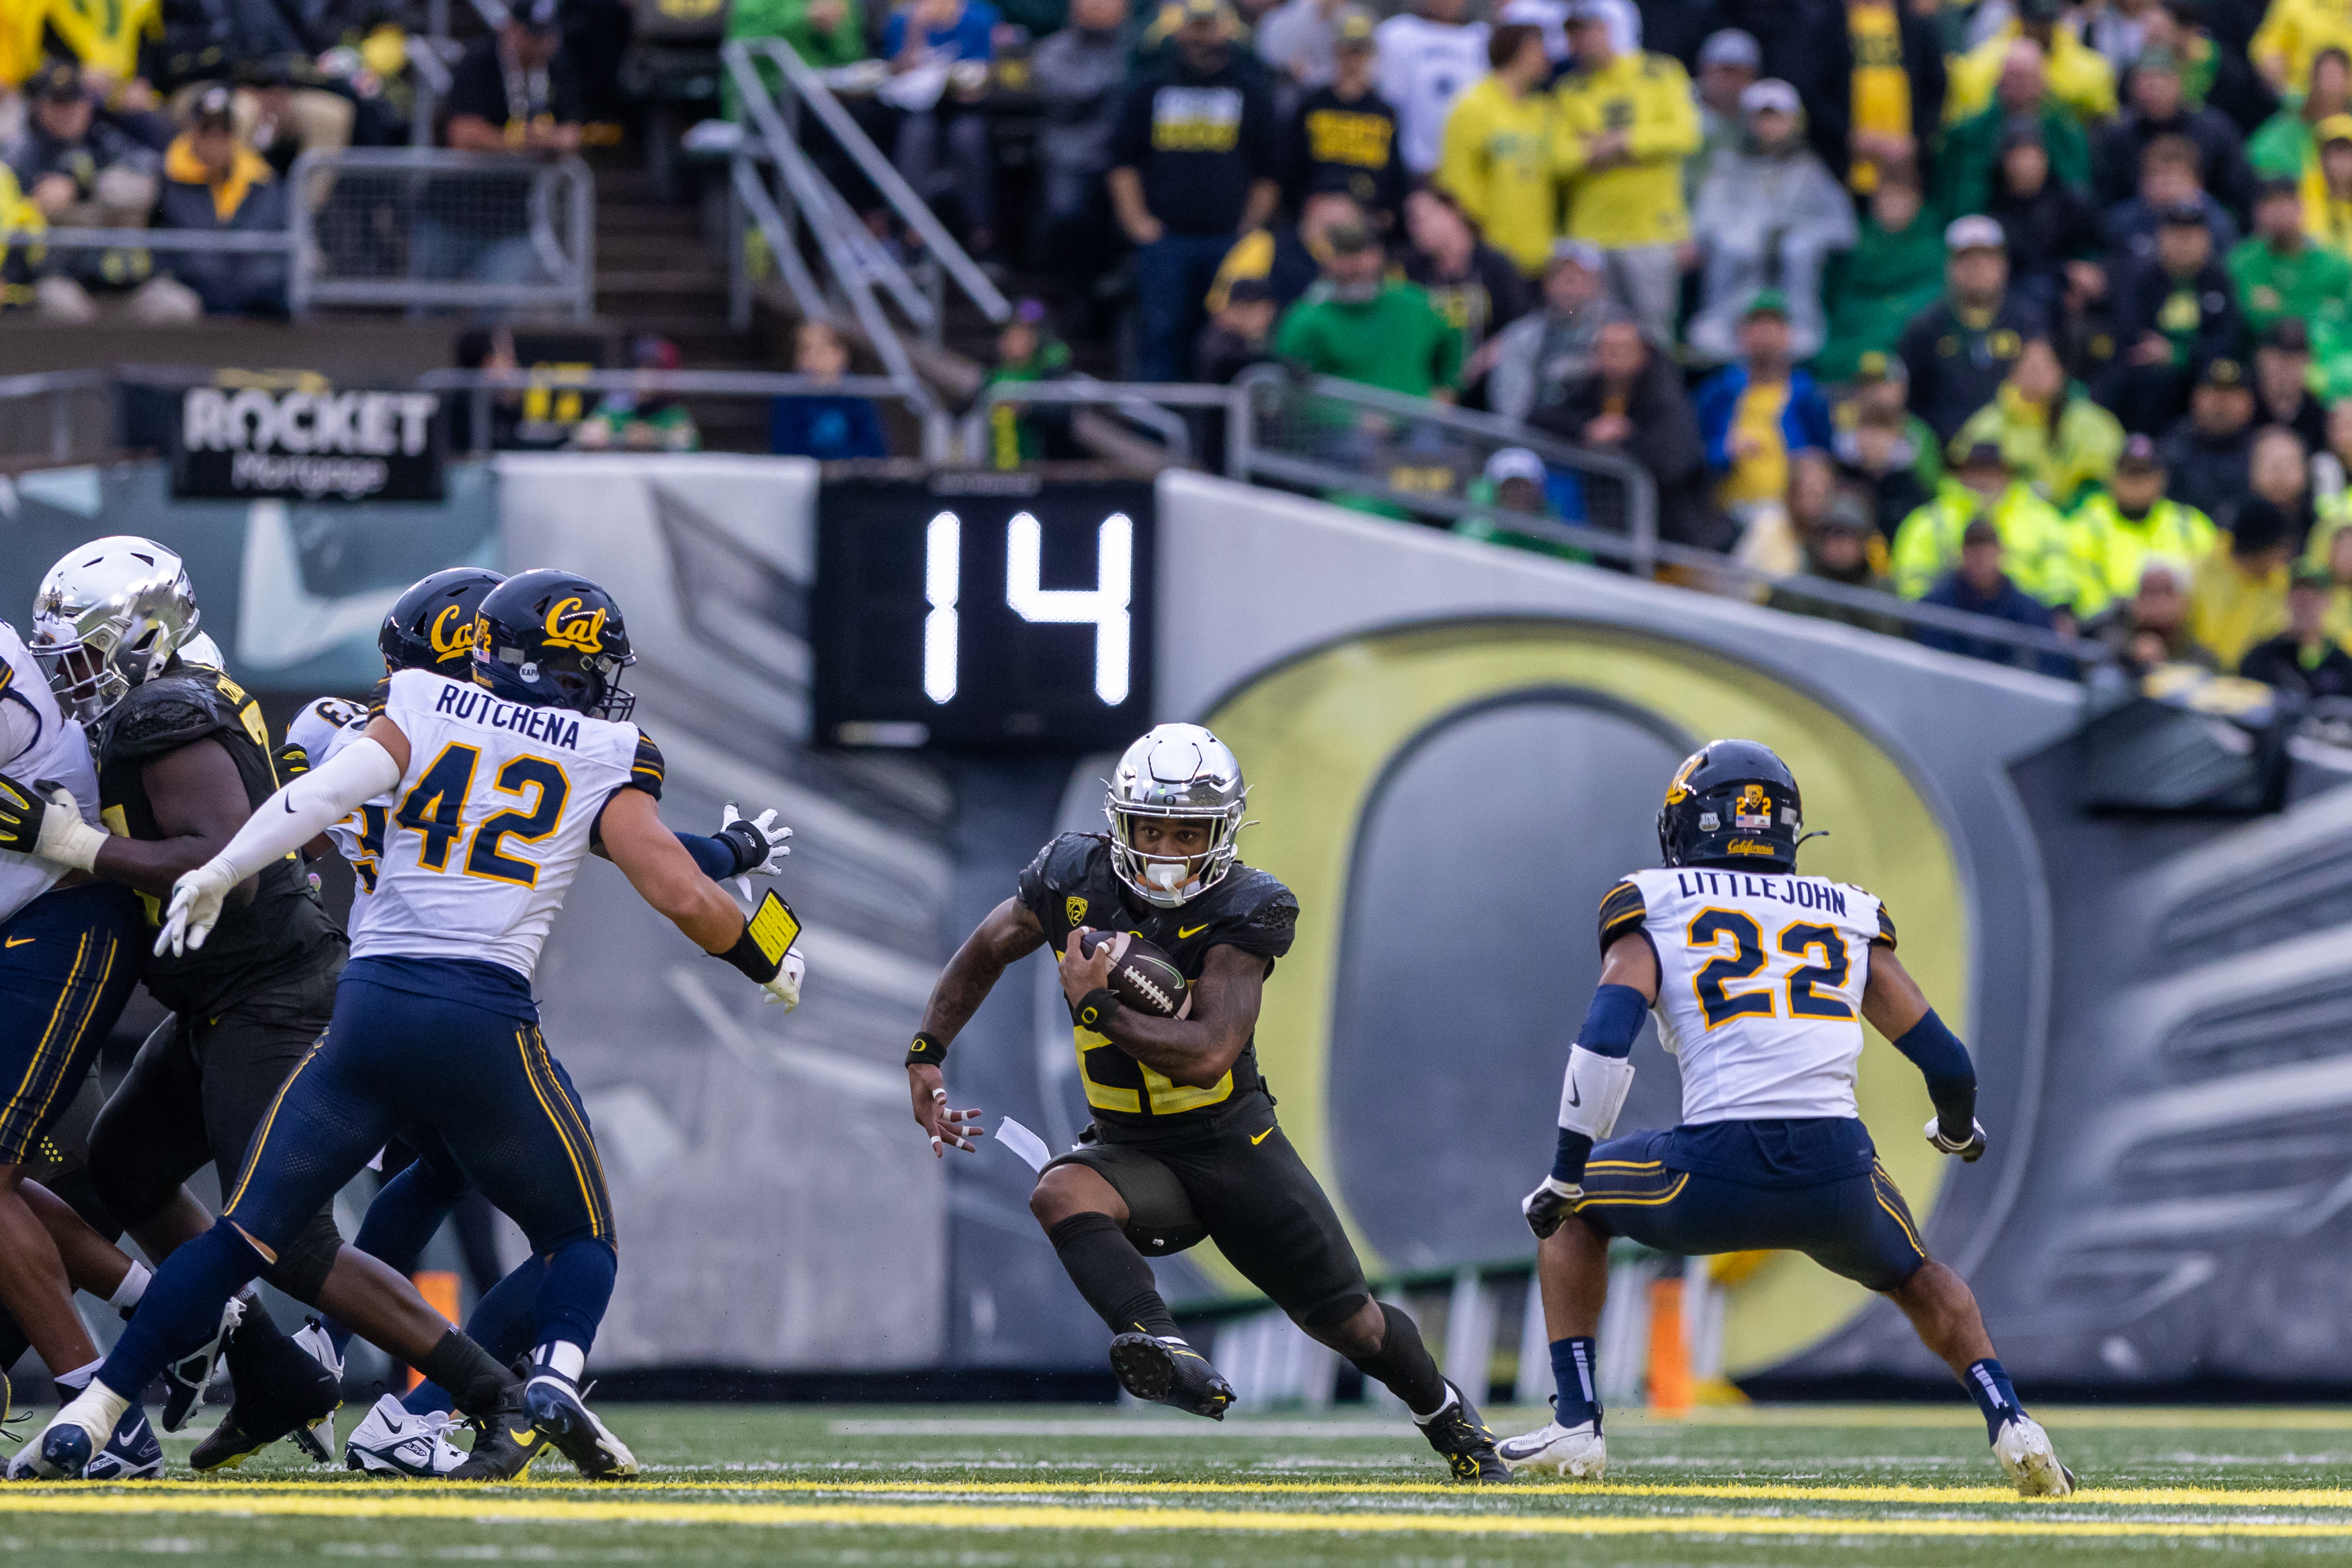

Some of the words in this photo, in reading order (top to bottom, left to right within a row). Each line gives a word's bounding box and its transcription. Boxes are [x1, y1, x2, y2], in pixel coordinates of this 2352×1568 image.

[183, 388, 438, 456] ROCKET
[431, 605, 478, 664] Ca
[542, 597, 606, 654] Cal
[924, 511, 1132, 705] 14
[435, 683, 580, 751] RUTCHENA
[394, 740, 572, 891] 42
[1727, 838, 1775, 856] California
[1070, 910, 1081, 921] 12
[1678, 871, 1847, 918] LITTLEJOHN
[1686, 906, 1859, 1031] 22
[91, 1457, 116, 1470] ALPHA
[402, 1442, 427, 1456] ALPHA
